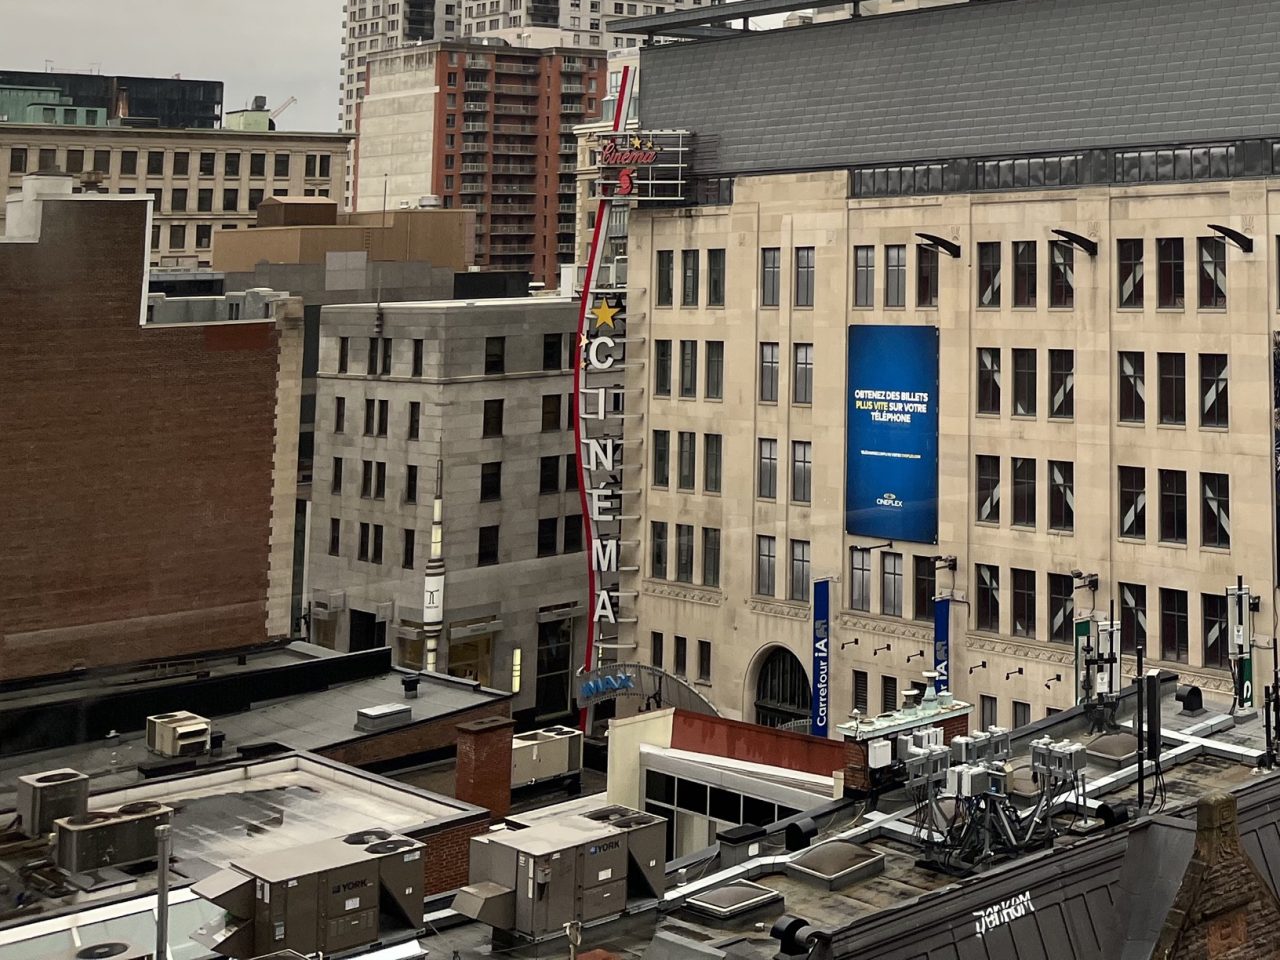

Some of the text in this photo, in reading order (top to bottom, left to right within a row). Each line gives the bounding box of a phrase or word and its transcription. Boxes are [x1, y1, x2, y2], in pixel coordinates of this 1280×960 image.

[854, 389, 929, 402] OBTENEZ DES BILLETS
[855, 401, 928, 413] PLUS VITE SUR VOTRE
[870, 410, 912, 423] TÉLÉPHONE
[589, 336, 618, 624] CINÉMA
[876, 498, 903, 508] CINEPLEX
[815, 638, 828, 727] Carrefour iA
[597, 840, 620, 853] YORK
[342, 879, 368, 892] YORK
